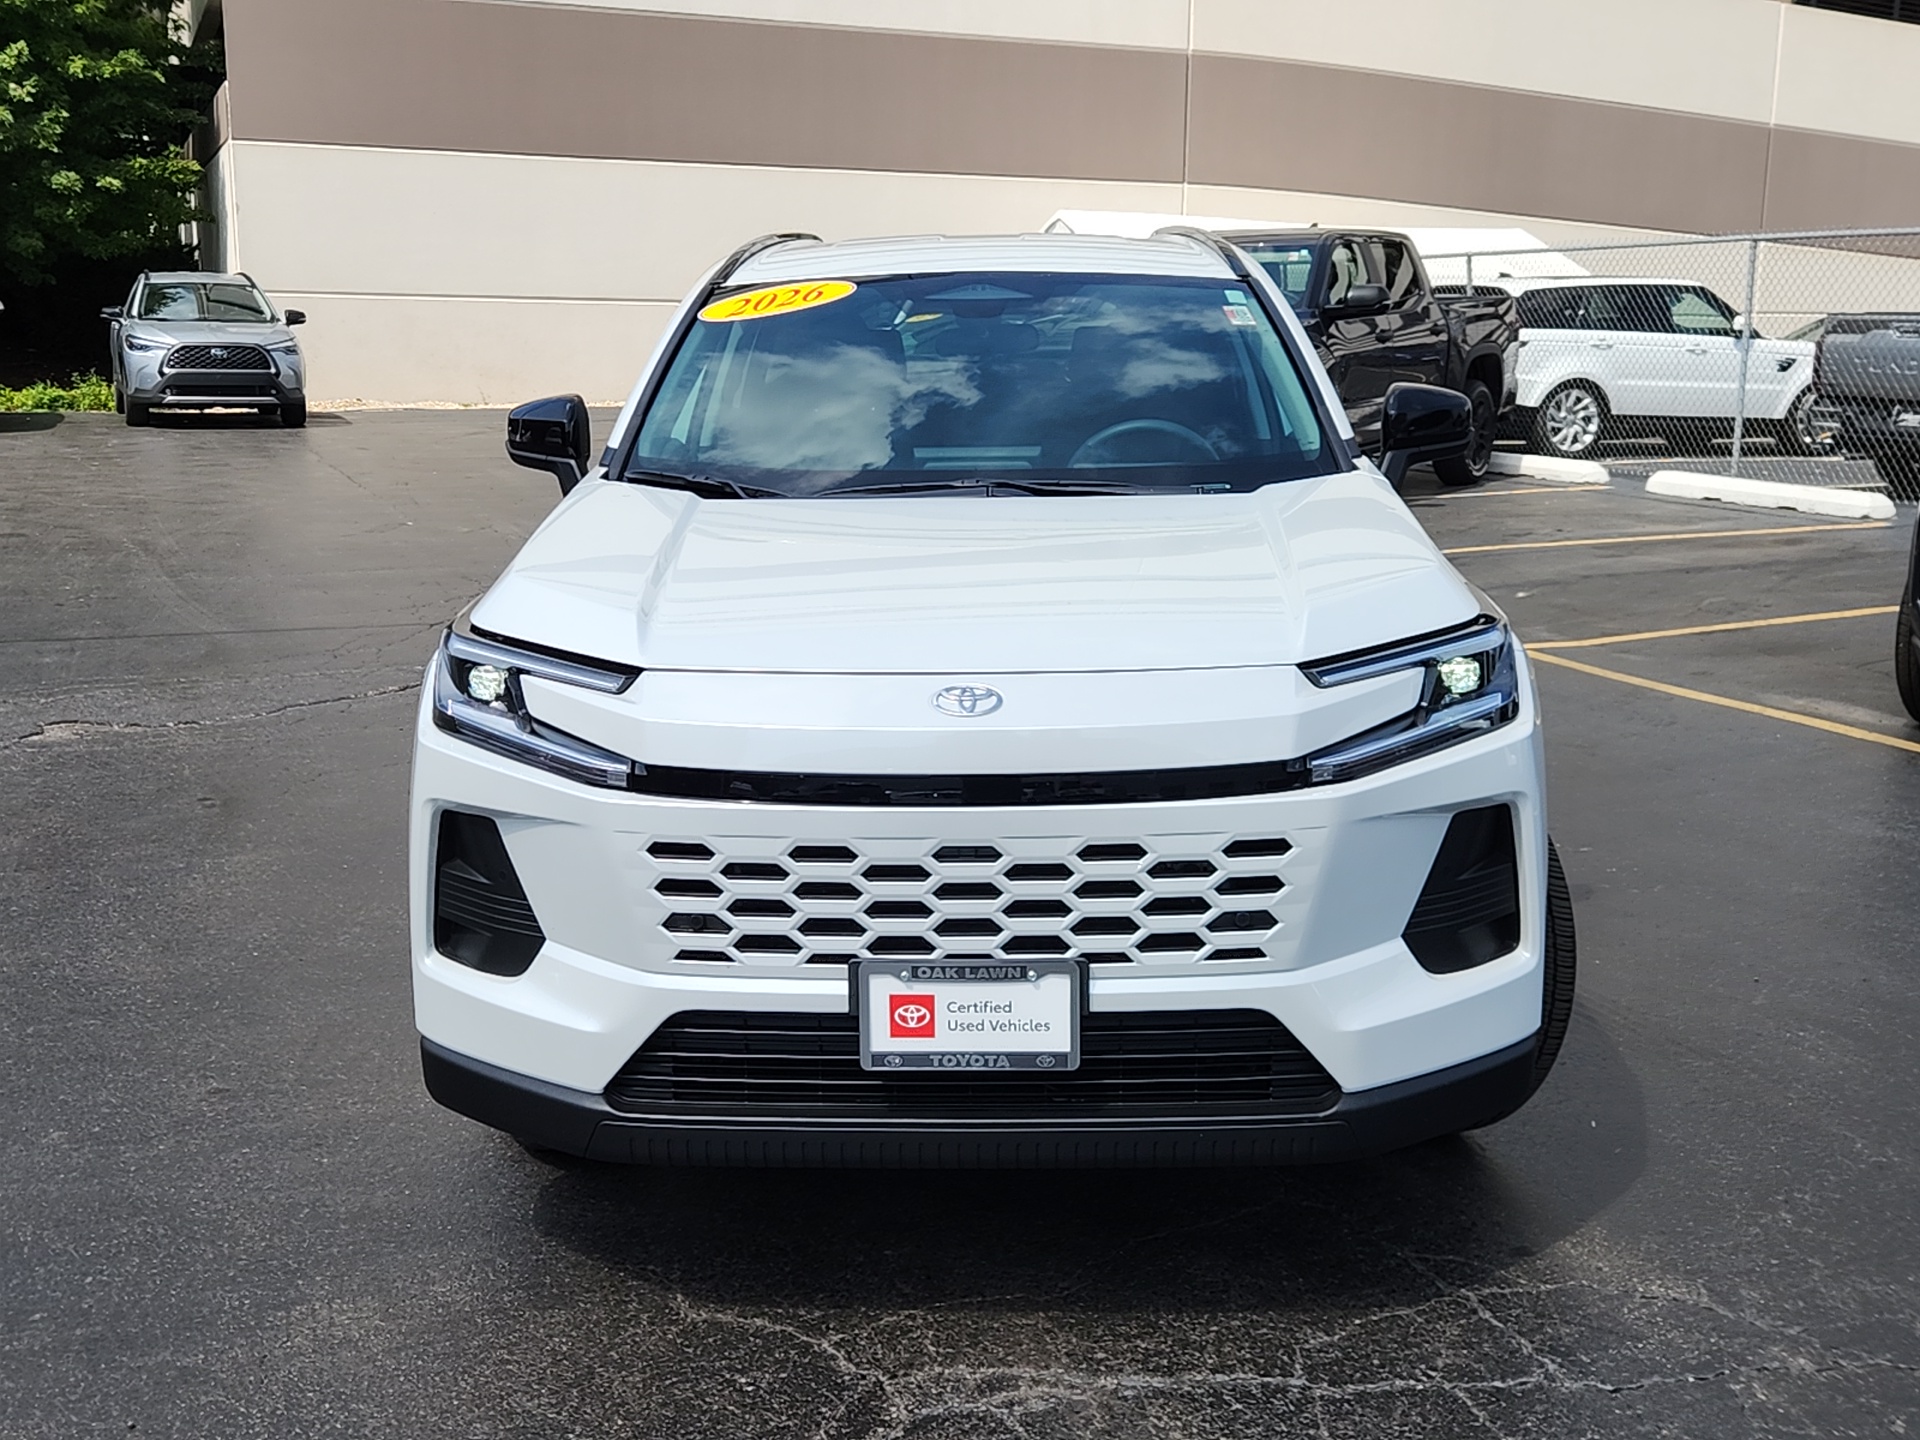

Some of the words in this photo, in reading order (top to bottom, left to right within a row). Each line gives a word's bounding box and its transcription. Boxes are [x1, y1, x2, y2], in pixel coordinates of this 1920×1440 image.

[725, 283, 829, 318] 2026
[917, 966, 958, 979] OAK
[965, 966, 1021, 979] LAWN
[947, 1000, 1013, 1014] Certified
[948, 1019, 985, 1032] Used
[989, 1019, 1051, 1032] Vehicles
[929, 1055, 1010, 1068] TOYOTA
